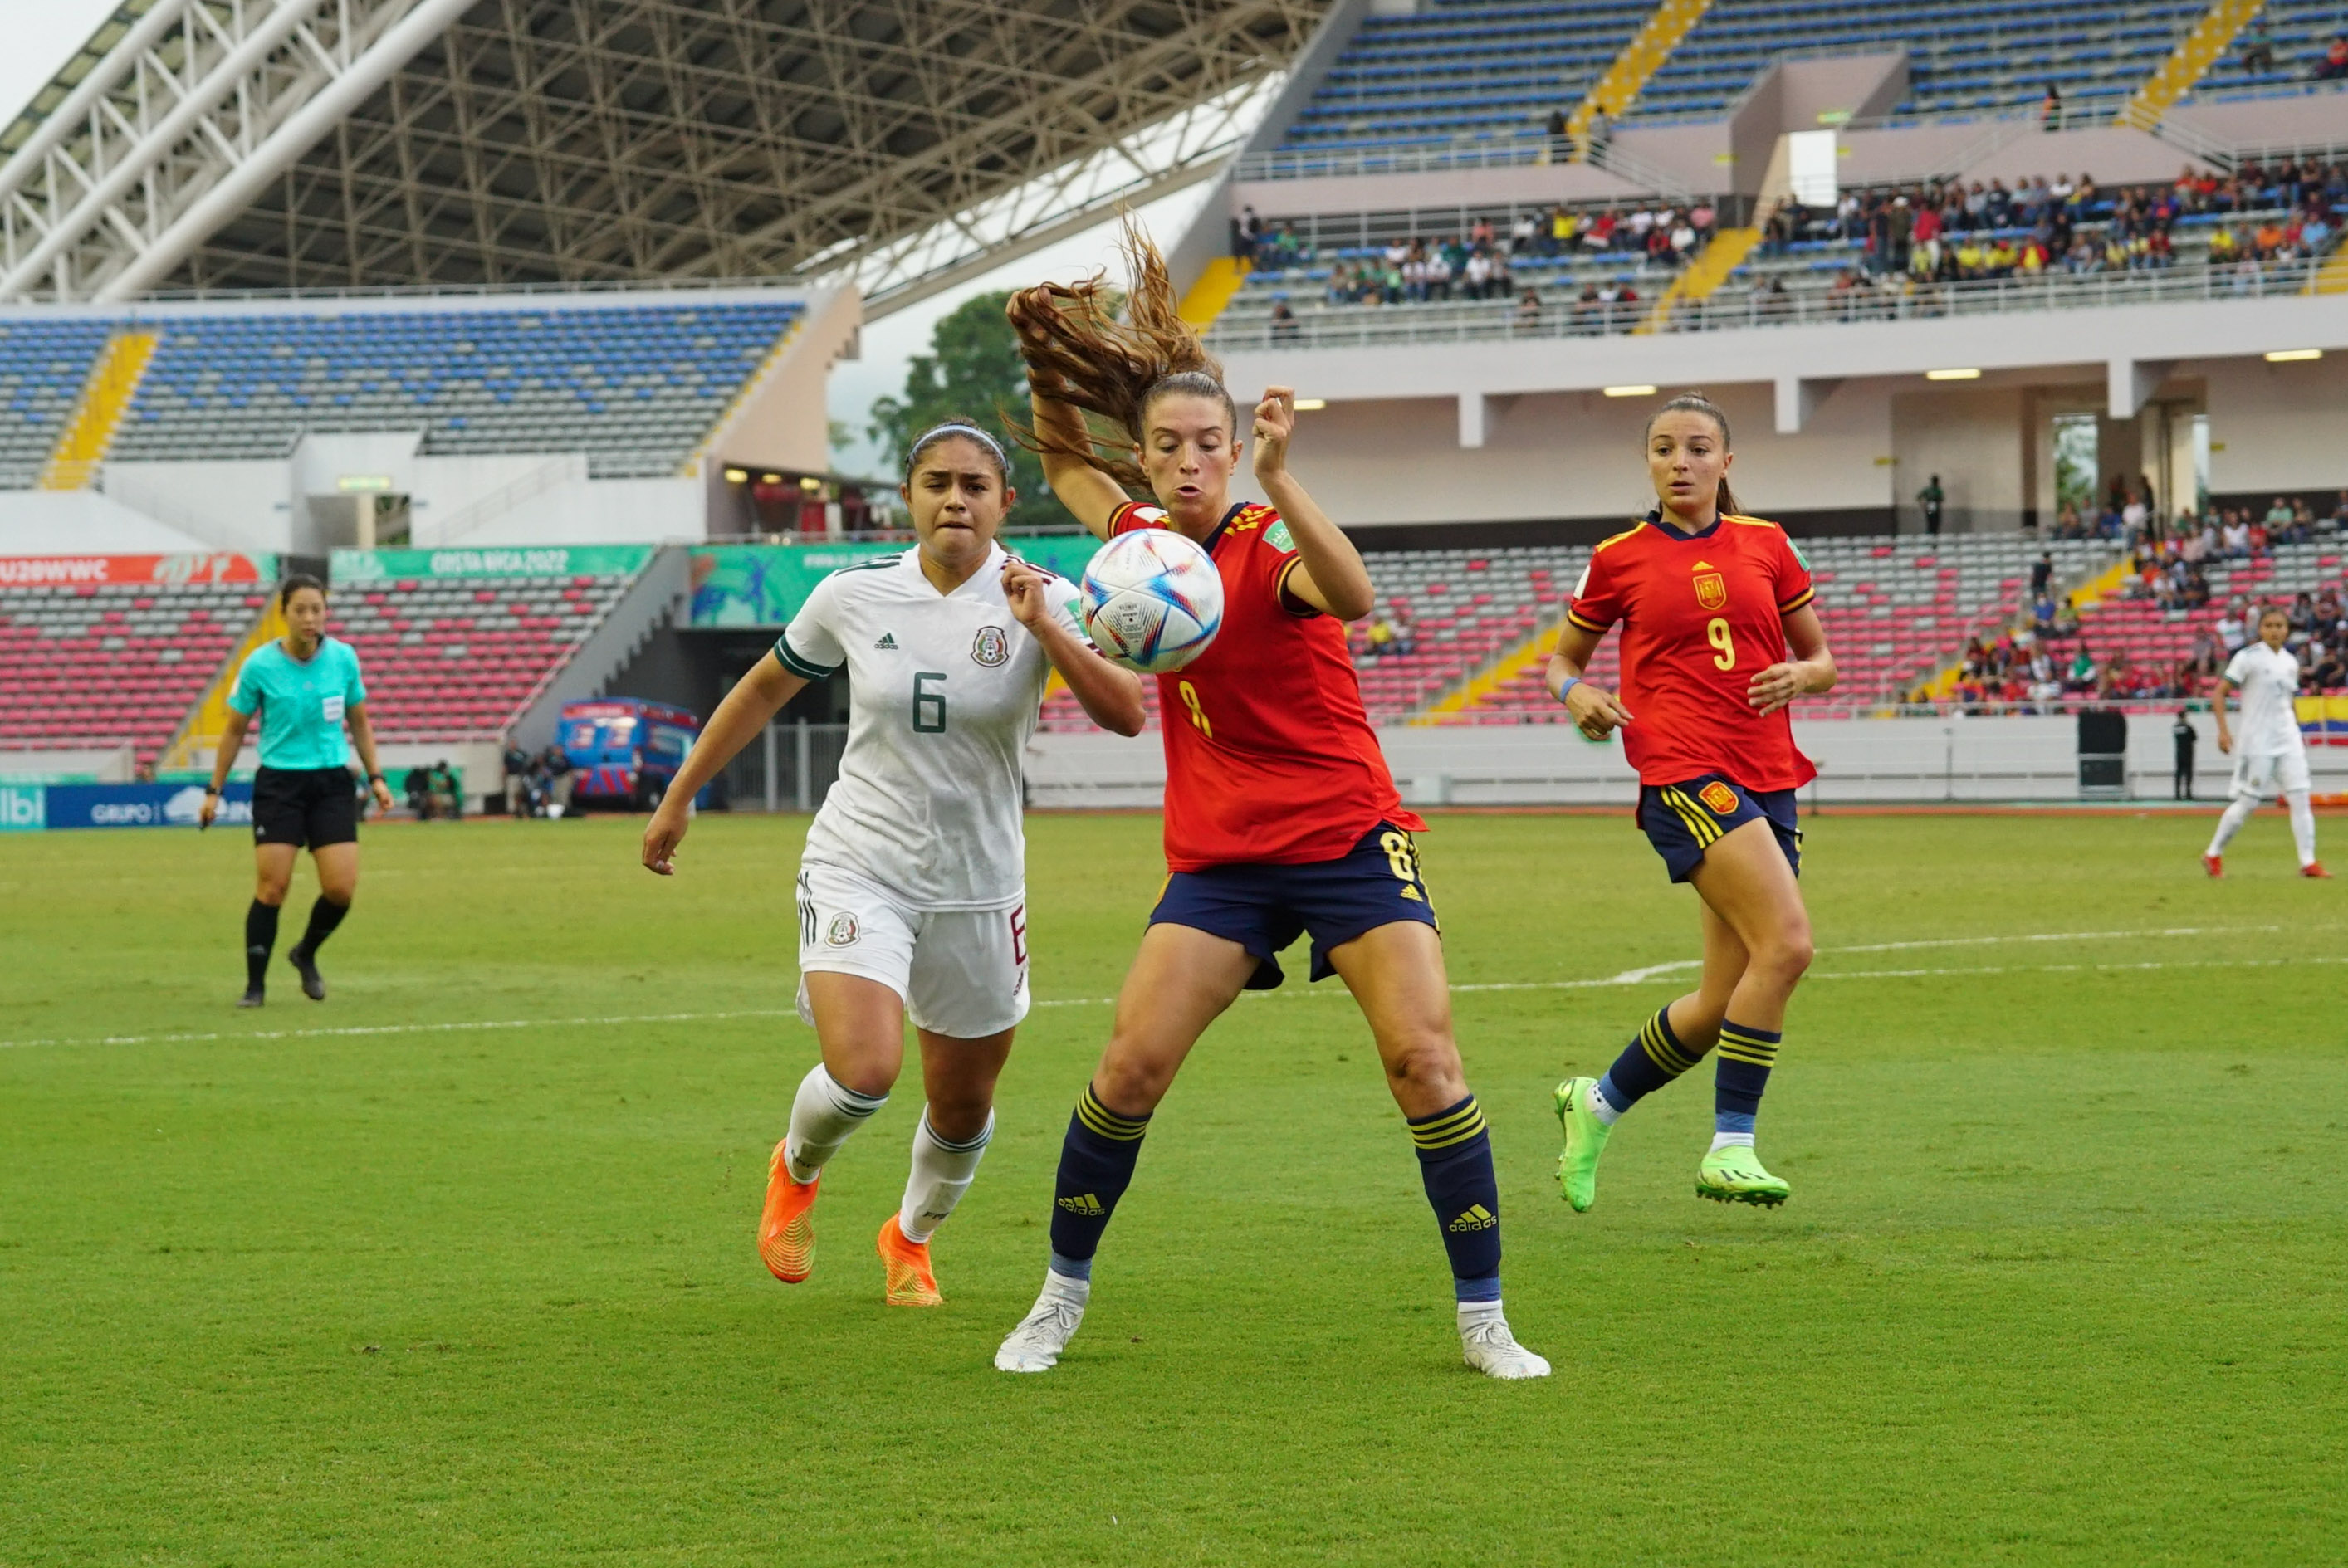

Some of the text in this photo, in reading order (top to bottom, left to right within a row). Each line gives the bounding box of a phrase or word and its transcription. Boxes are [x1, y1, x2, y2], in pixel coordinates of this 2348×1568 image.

[1707, 617, 1736, 671] 9
[913, 672, 947, 733] 6
[1179, 680, 1213, 739] 8
[90, 803, 153, 824] GRUPO
[1379, 831, 1415, 882] 8
[1058, 1197, 1106, 1216] adidas
[1449, 1215, 1497, 1232] adidas
